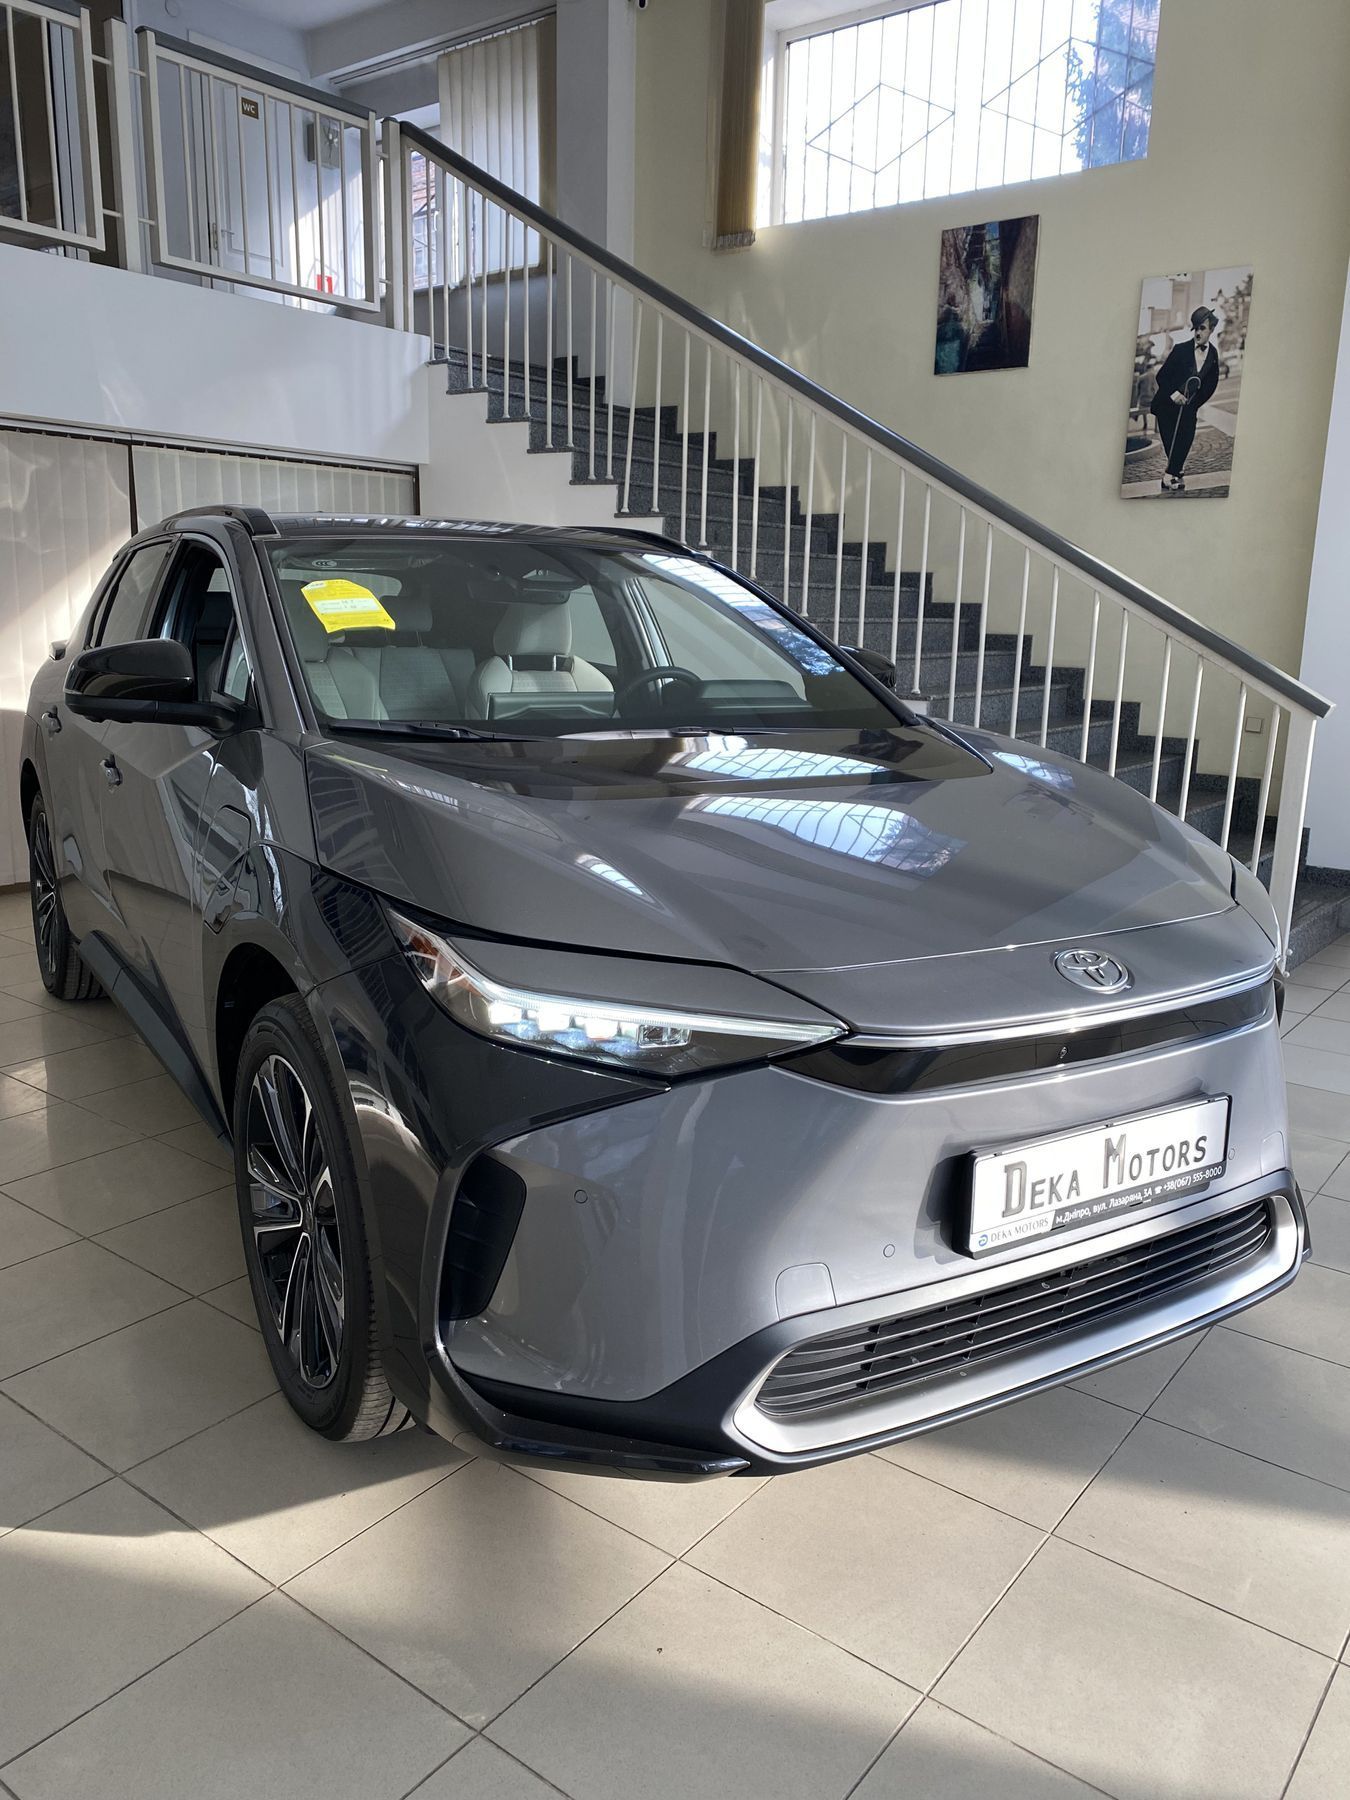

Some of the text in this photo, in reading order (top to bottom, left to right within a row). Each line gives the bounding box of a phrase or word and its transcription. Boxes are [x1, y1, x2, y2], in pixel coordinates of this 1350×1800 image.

[242, 102, 255, 114] WC
[1003, 1134, 1207, 1218] DEKA MOTORS
[1093, 1202, 1108, 1214] вул.
[1109, 1191, 1143, 1208] Лазаряна,
[1163, 1175, 1192, 1191] +38(067)
[1192, 1166, 1223, 1183] 555-8000
[990, 1218, 1049, 1243] DEKA MOTORS
